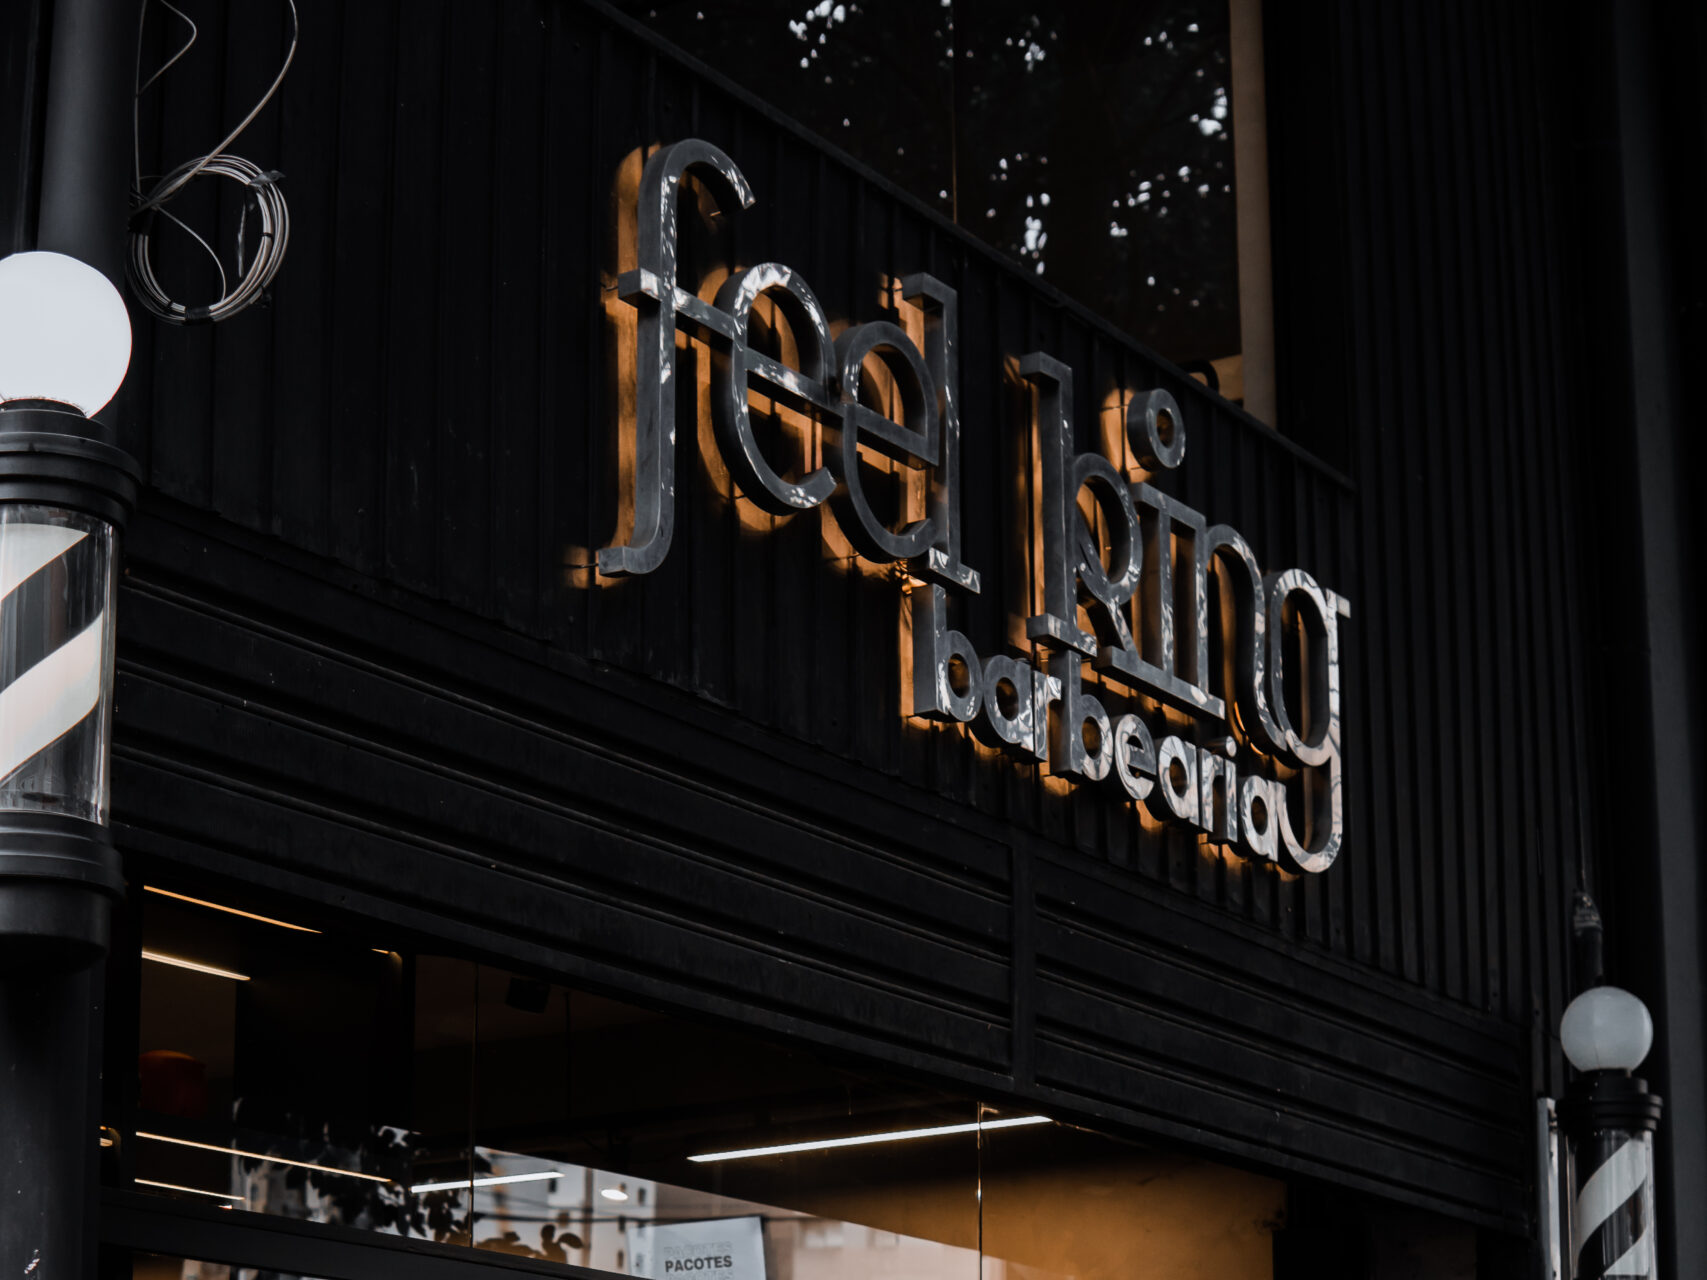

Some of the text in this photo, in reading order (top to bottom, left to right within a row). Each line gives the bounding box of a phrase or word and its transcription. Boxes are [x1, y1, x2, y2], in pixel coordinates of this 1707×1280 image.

[599, 137, 1352, 875] feel king
[913, 583, 1284, 863] barbearia
[664, 1255, 733, 1273] PACOTES
